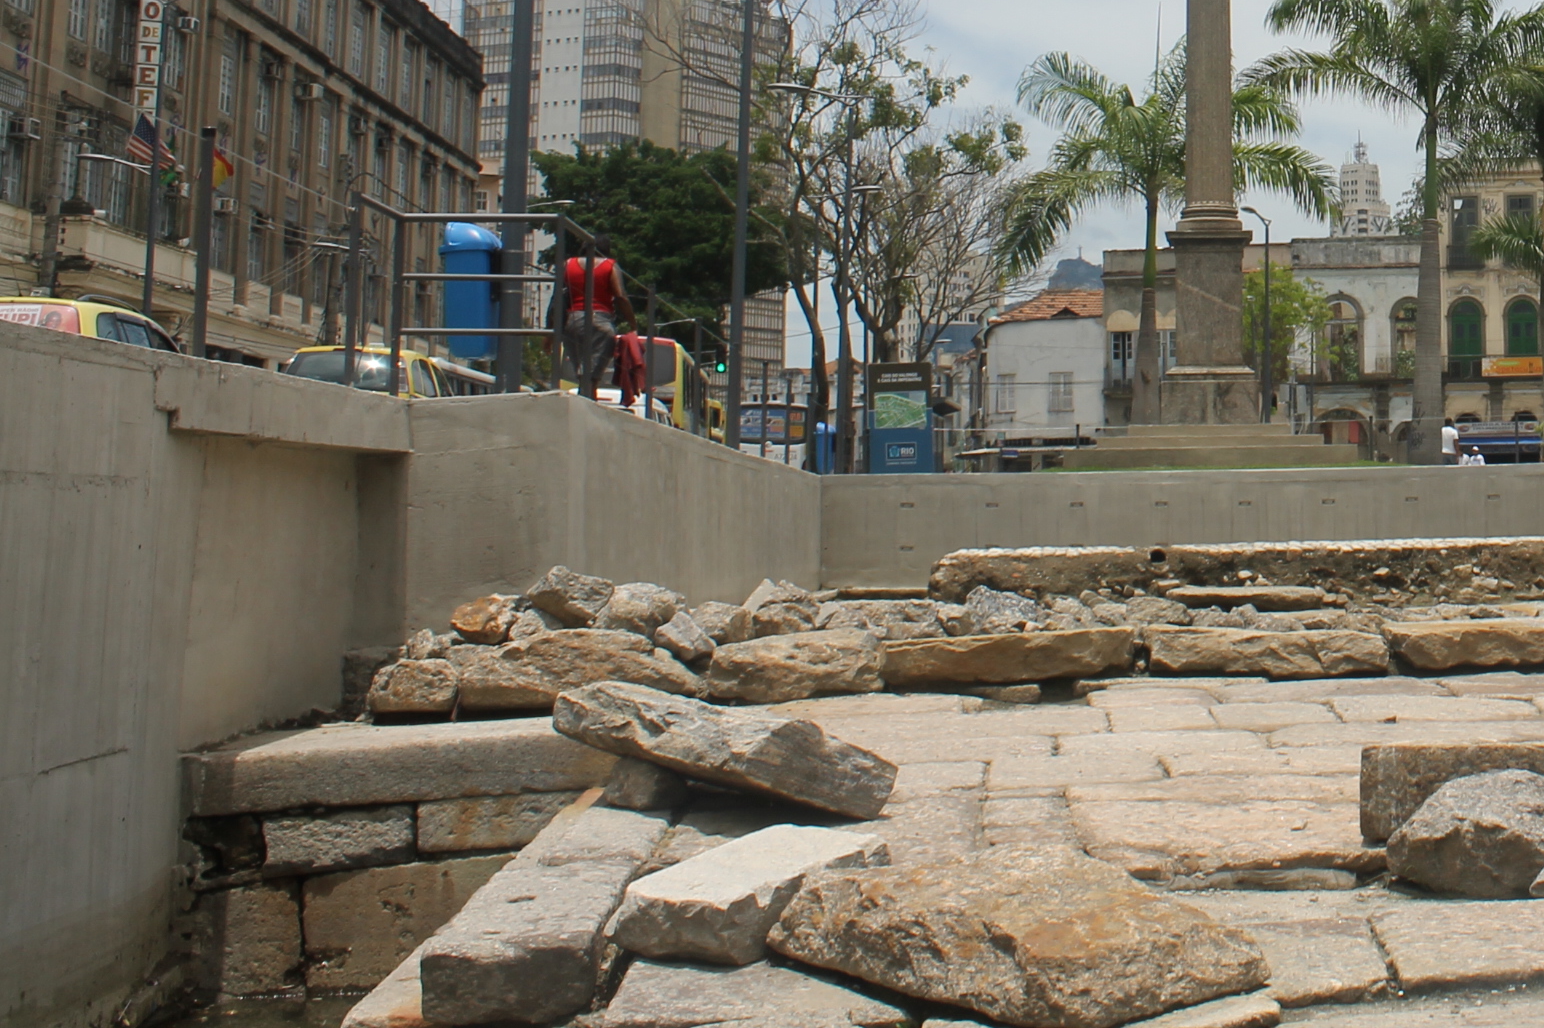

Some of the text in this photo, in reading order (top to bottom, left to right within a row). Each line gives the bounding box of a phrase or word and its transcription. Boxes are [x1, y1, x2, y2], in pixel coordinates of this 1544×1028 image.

[142, 25, 159, 38] DE
[138, 45, 157, 114] TEF
[0, 313, 37, 325] UPI
[900, 447, 915, 455] RIO
